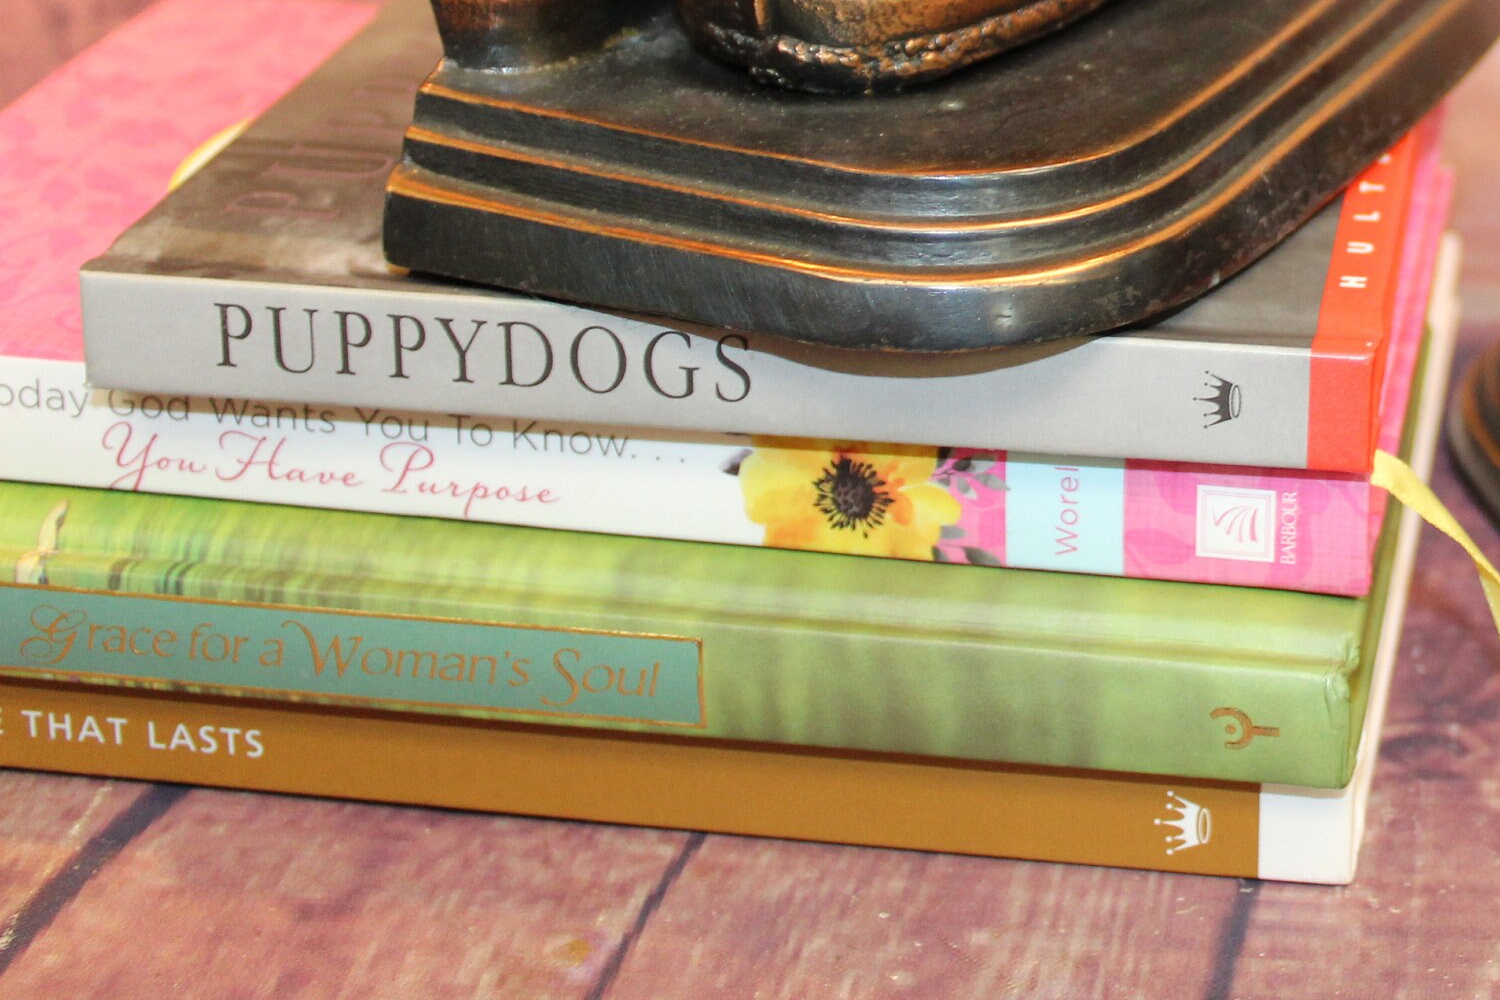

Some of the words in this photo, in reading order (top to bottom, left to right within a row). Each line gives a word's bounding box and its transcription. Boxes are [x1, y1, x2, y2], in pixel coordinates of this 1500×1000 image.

[1339, 153, 1392, 288] HULT
[213, 302, 753, 403] PUPPYDOGS
[101, 421, 206, 491] You
[214, 430, 362, 487] Have
[379, 442, 561, 518] Purpose
[208, 397, 336, 433] Wants
[354, 407, 429, 443] You
[448, 414, 494, 446] To
[1279, 490, 1298, 565] BARBOUR
[19, 603, 178, 666] Grace
[189, 622, 249, 665] for
[258, 637, 286, 668] a
[281, 620, 532, 688] Woman's
[540, 648, 661, 708] Soul
[20, 709, 129, 745] THAT
[147, 720, 265, 759] LASTS
